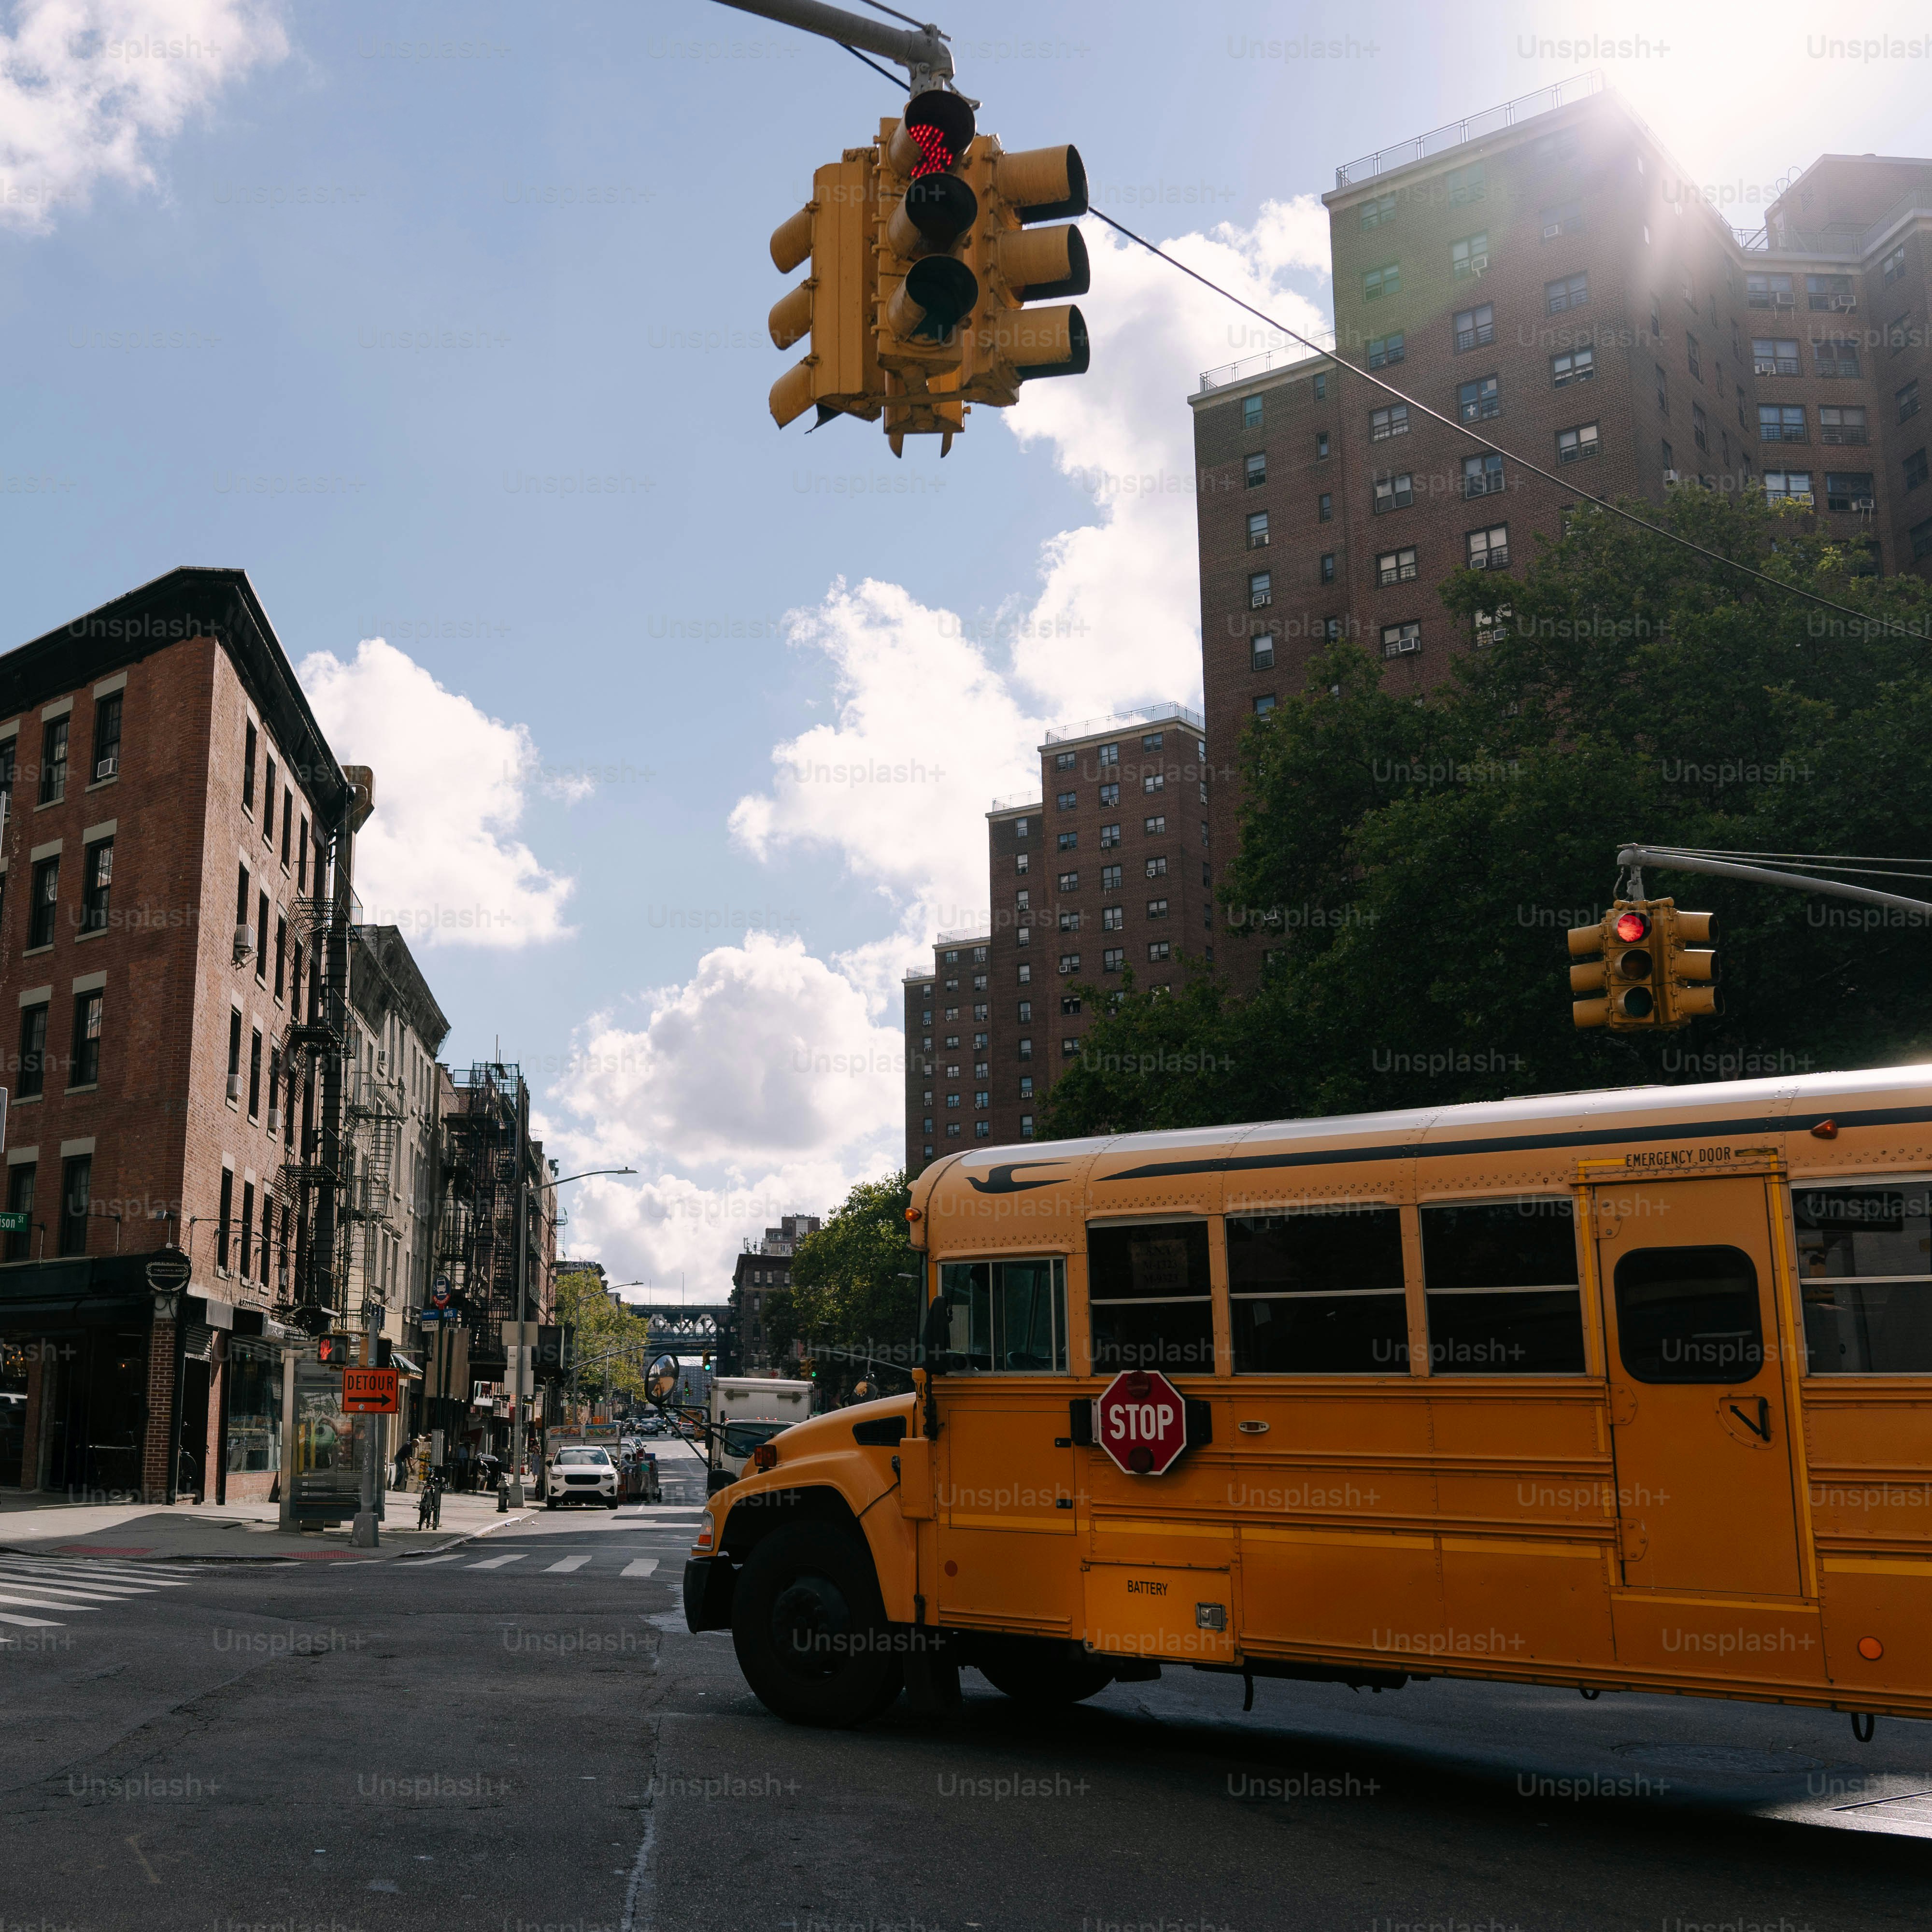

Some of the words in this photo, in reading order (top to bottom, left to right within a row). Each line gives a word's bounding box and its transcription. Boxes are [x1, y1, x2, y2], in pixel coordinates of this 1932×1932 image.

[1626, 1150, 1693, 1167] EMERGENCY
[1699, 1147, 1731, 1163] DOOR
[348, 1375, 394, 1391] DETOUR
[1110, 1404, 1174, 1440] STOP
[1128, 1580, 1168, 1596] BATTERY
